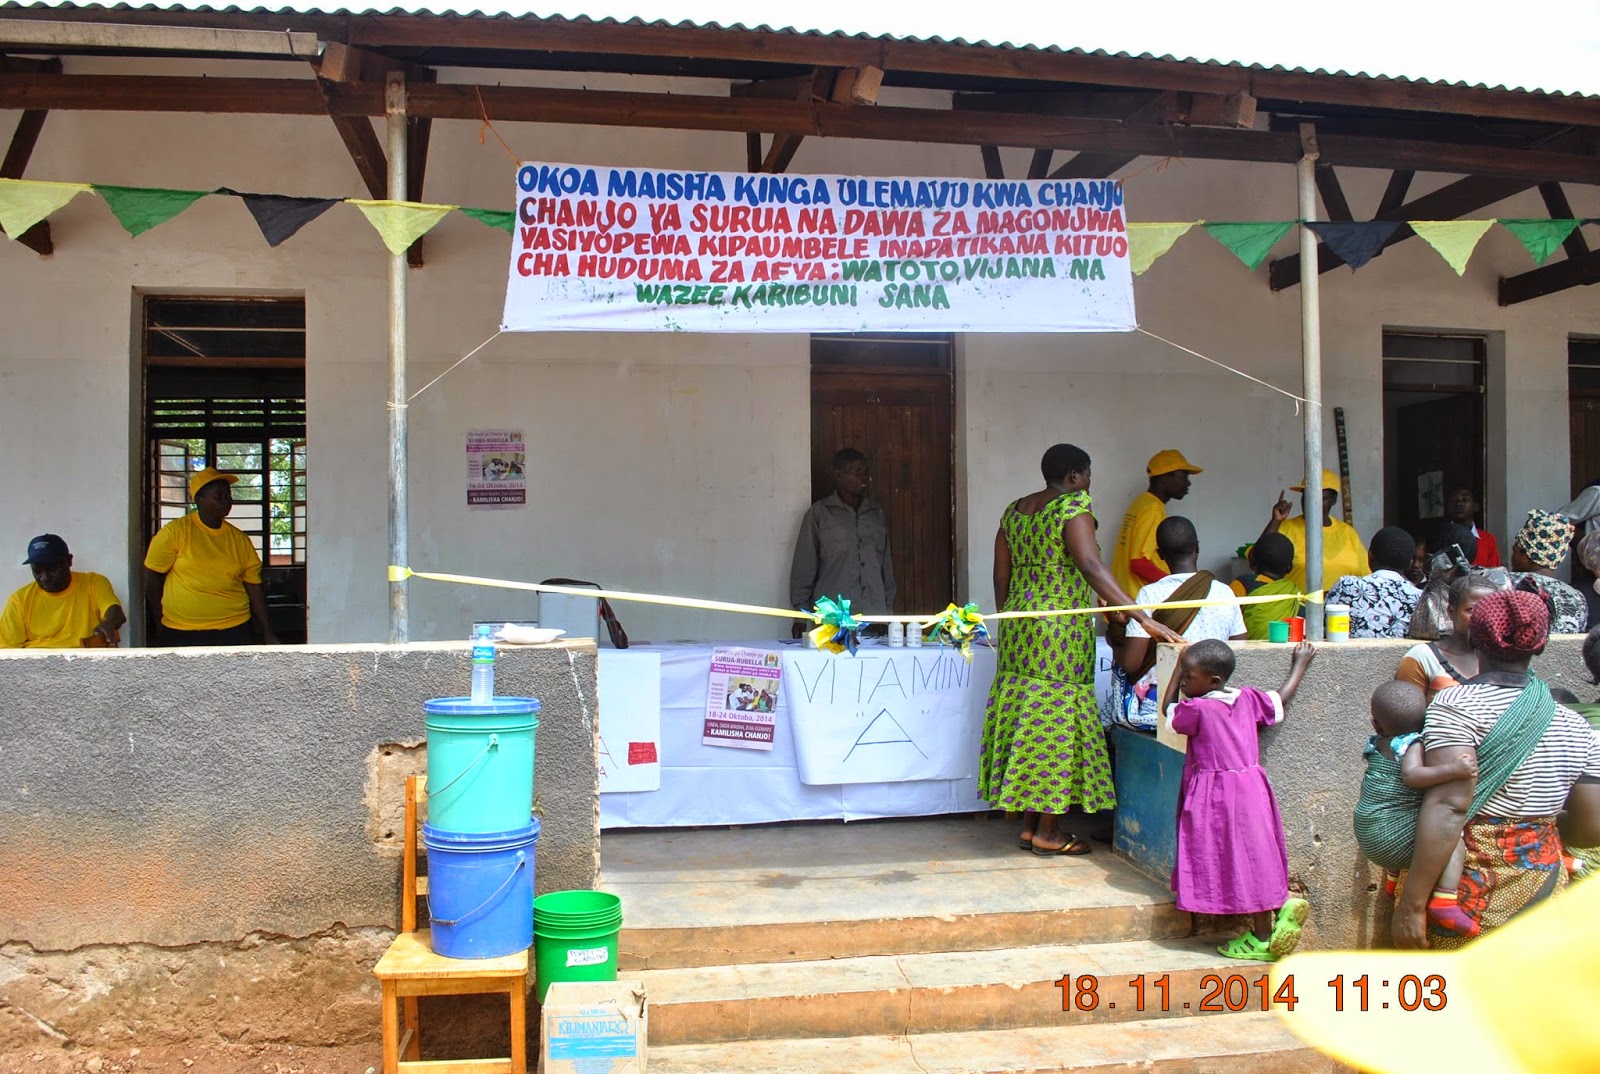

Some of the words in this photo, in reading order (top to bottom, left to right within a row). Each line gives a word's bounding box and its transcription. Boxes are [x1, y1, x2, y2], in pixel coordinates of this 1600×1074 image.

[518, 165, 599, 198] OKOA
[608, 170, 726, 202] MAISHA
[734, 175, 830, 206] KINGA
[837, 178, 969, 208] ULEMAVU
[973, 182, 1033, 209] KWA
[1038, 181, 1123, 212] CHANJO
[520, 197, 637, 233] CHANJO
[649, 203, 682, 235] YA
[690, 204, 792, 234] SURUA
[797, 207, 837, 235] NA
[844, 209, 926, 238] DAWA
[933, 210, 971, 237] ZA
[976, 207, 1125, 235] MAGONJWA
[520, 226, 692, 255] YASIYOPEWA
[698, 235, 870, 260] KIPAUMBELE
[879, 233, 1050, 258] INAPATIKANA
[1054, 234, 1128, 258] KITUO
[517, 252, 570, 277] CHA
[577, 254, 703, 281] HUDUMA
[709, 260, 745, 283] ZA
[963, 257, 1056, 280] VIJANA
[1069, 258, 1106, 281] NA
[635, 284, 728, 306] WAZEE
[730, 284, 858, 309] KARIBUNI
[878, 283, 950, 310] SANA
[715, 656, 762, 666] SURUA-RUBELLA
[795, 655, 973, 704] VITAMINI
[709, 711, 727, 719] 18-24
[729, 713, 754, 721] Oktoba,
[711, 728, 743, 737] KAMILISHA
[745, 731, 771, 740] CHANJO!
